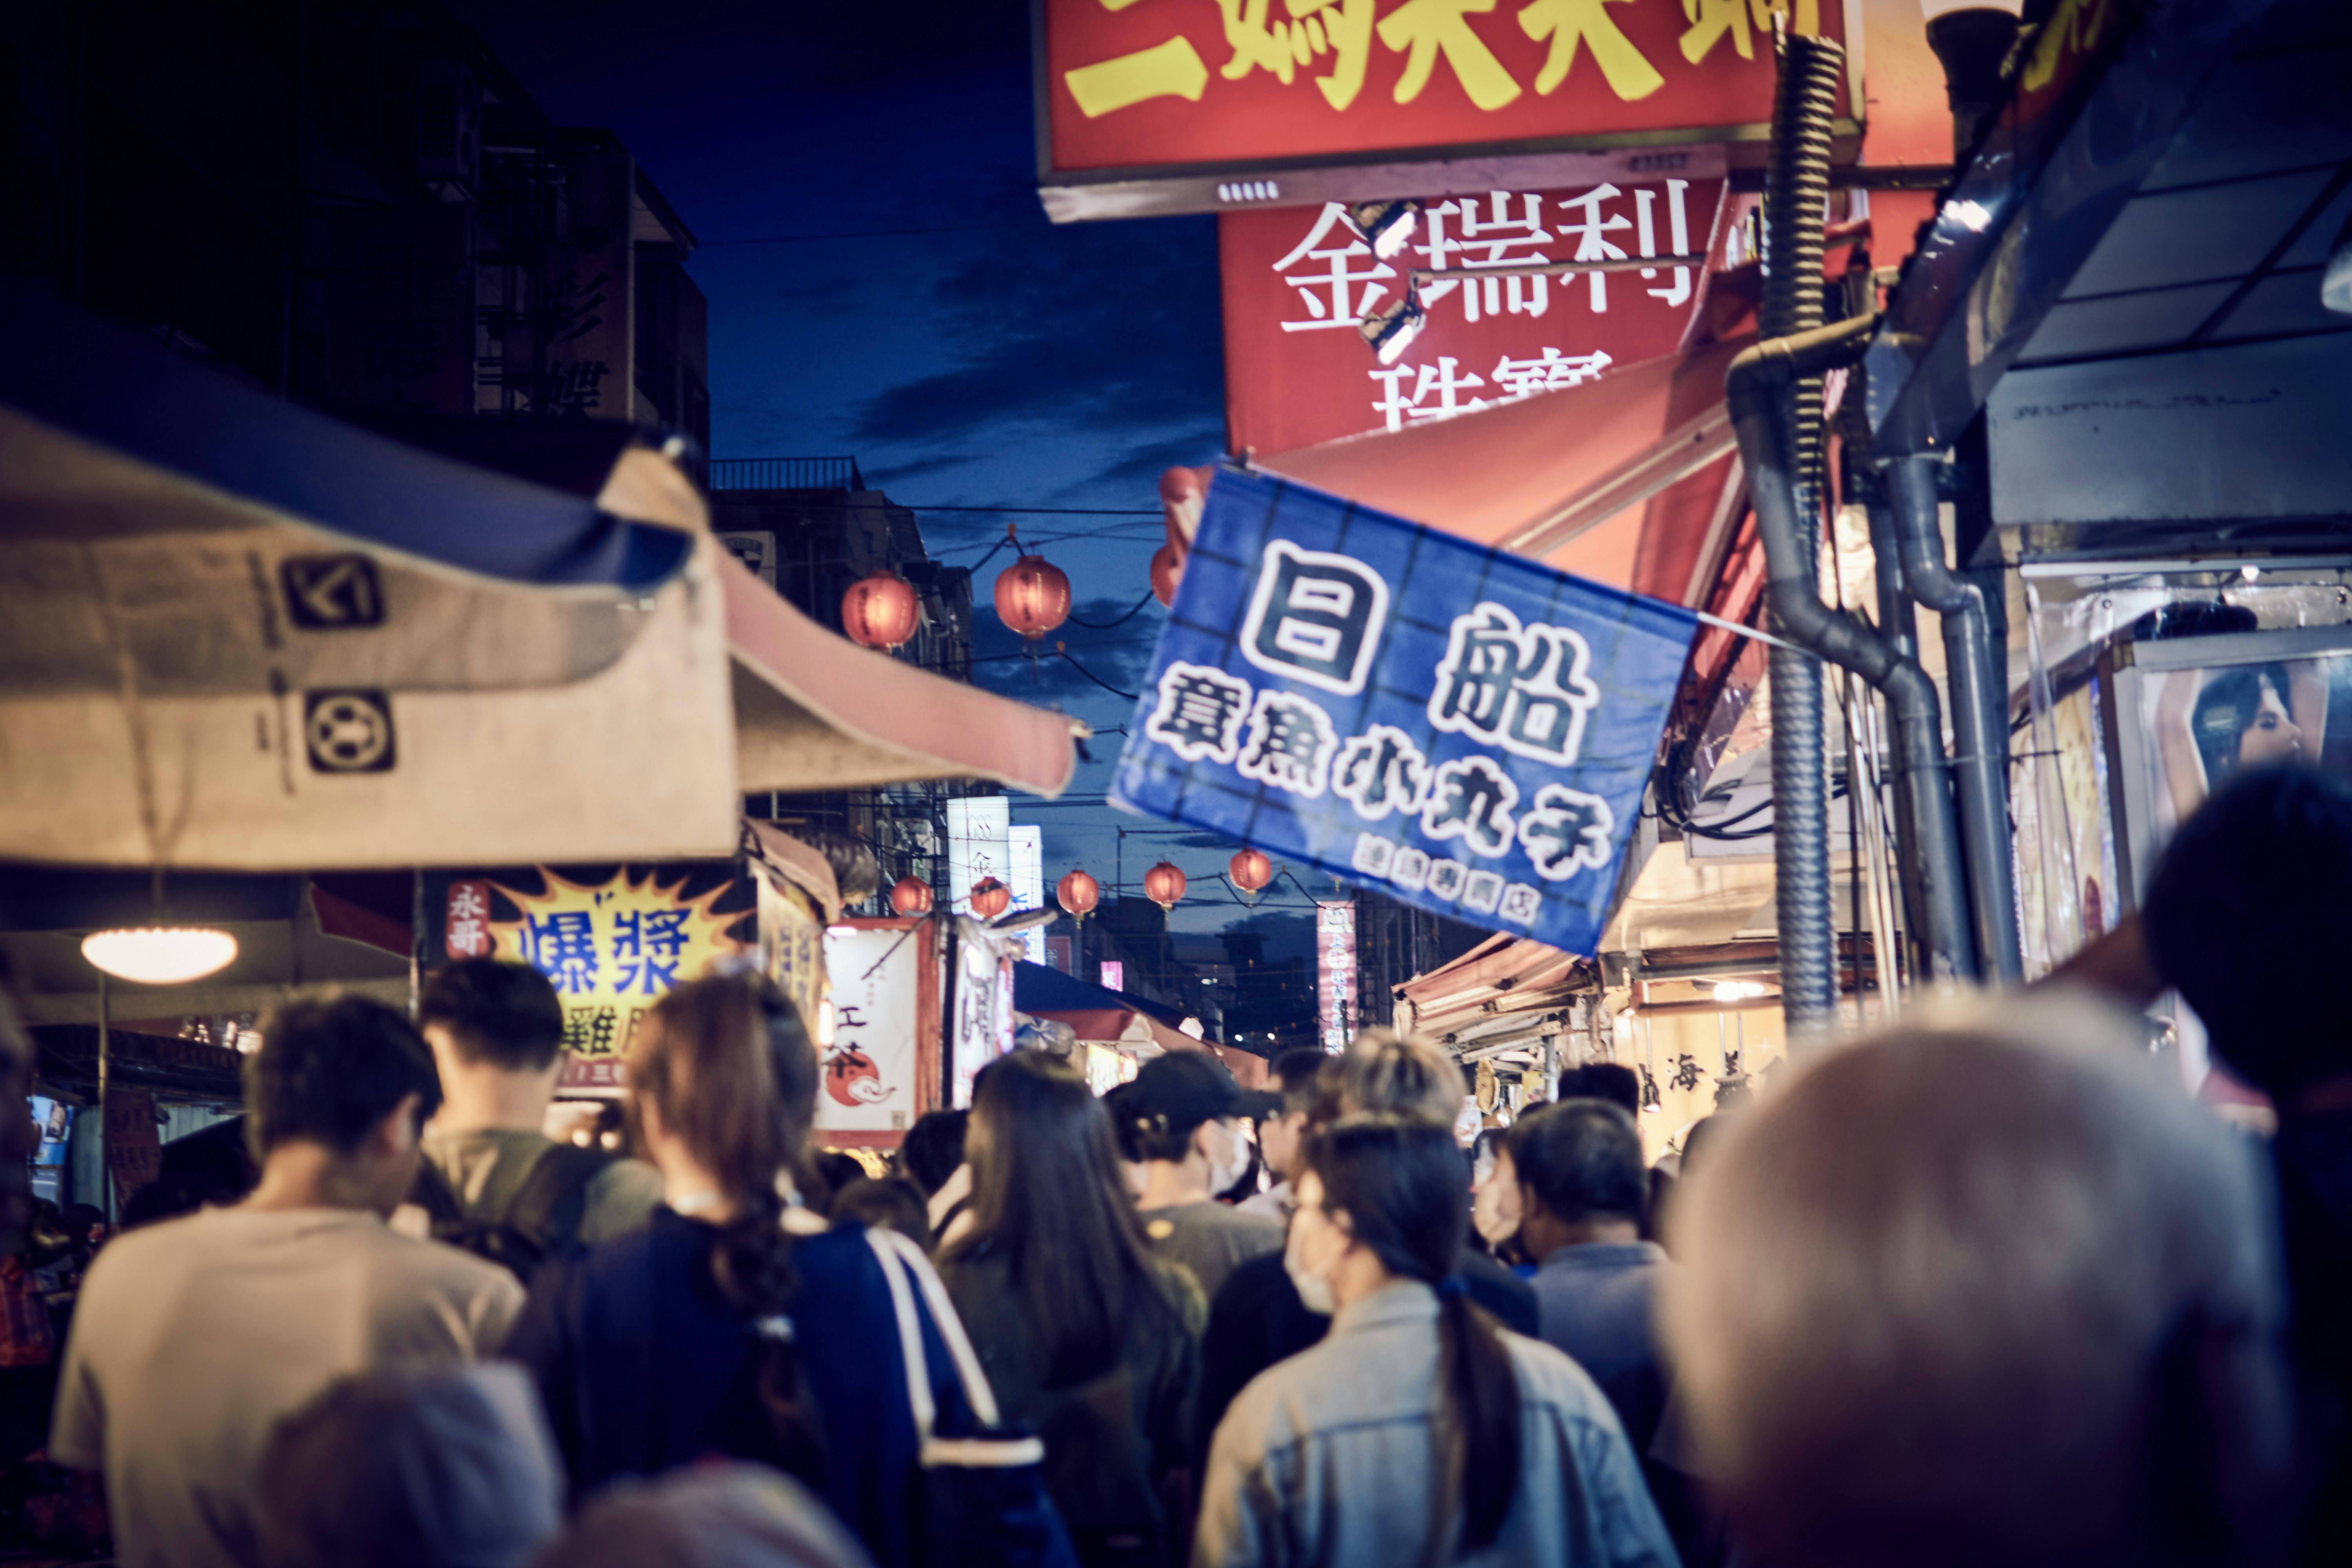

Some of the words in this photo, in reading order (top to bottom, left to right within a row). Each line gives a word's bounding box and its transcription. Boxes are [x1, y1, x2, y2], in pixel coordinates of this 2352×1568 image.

[1273, 179, 1691, 332] 金瑞利
[1147, 661, 1615, 882] 章魚小丸子
[449, 885, 486, 956] 永哥
[518, 908, 693, 995] 爆漿
[561, 1005, 646, 1054] 雞
